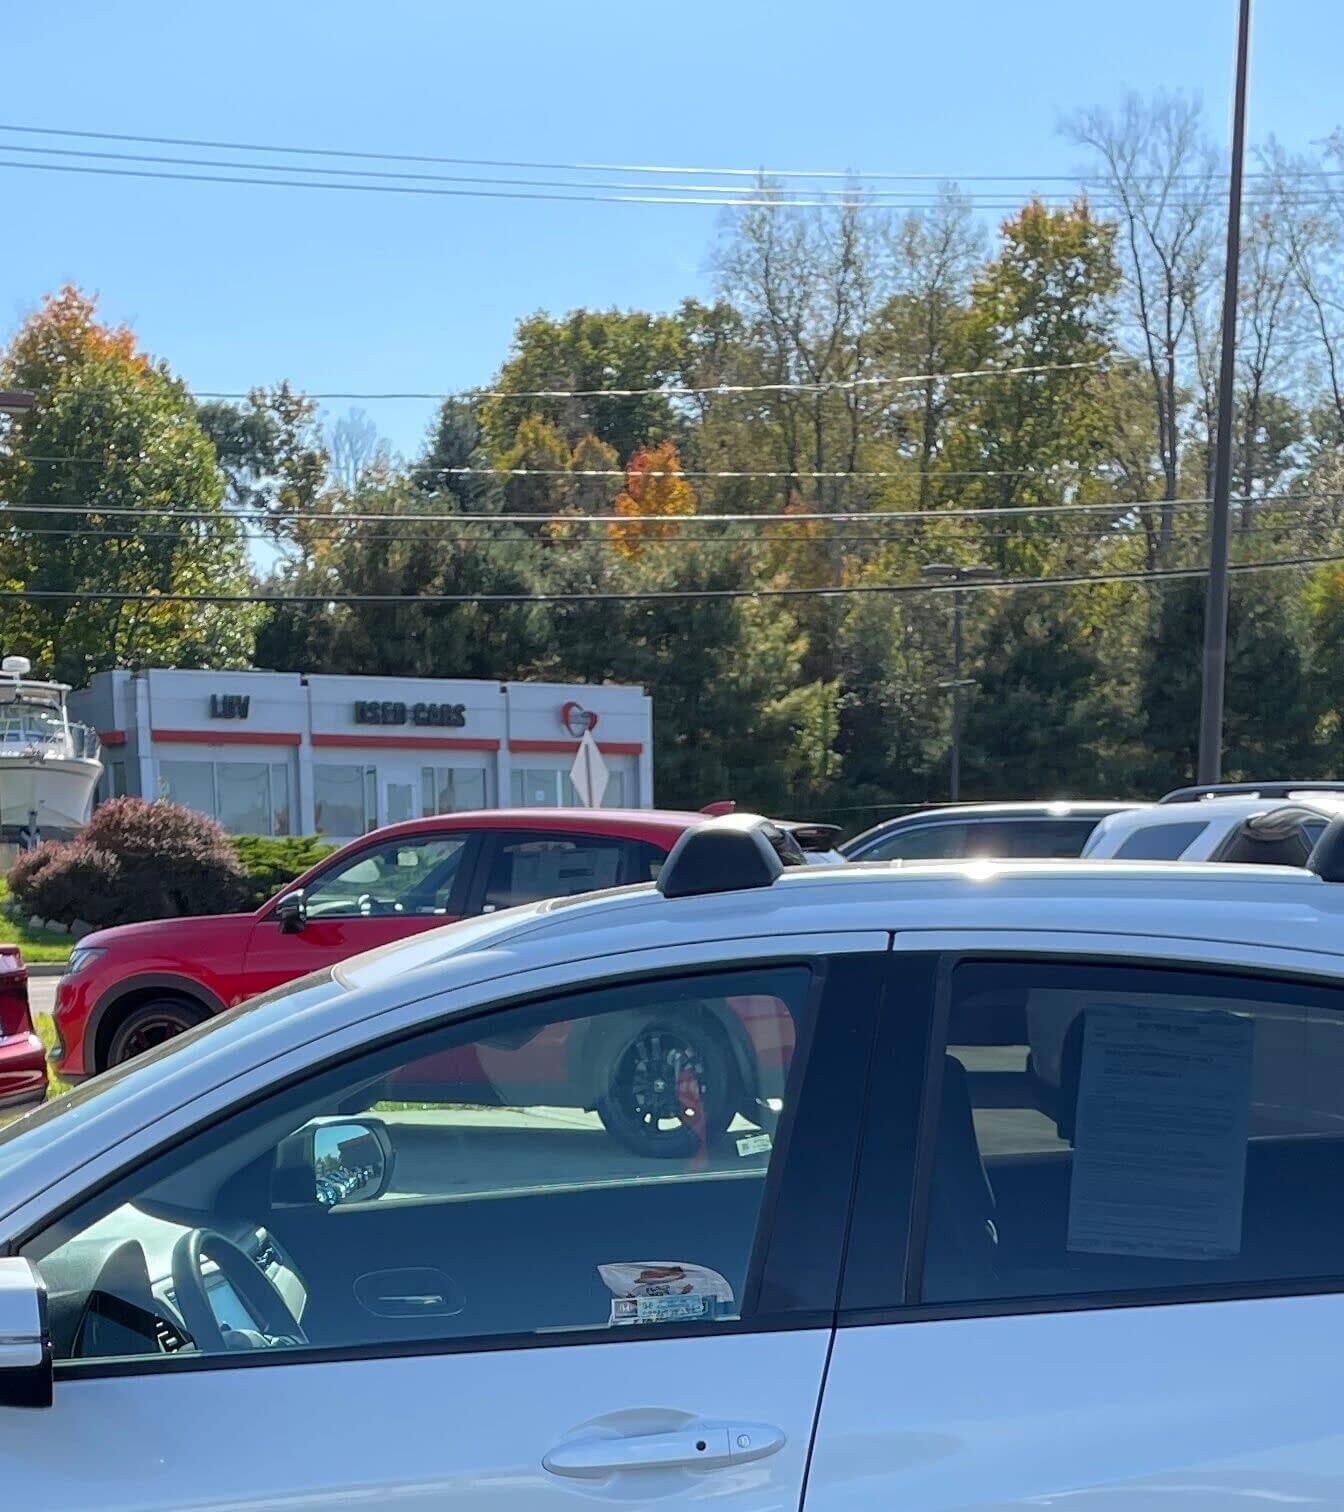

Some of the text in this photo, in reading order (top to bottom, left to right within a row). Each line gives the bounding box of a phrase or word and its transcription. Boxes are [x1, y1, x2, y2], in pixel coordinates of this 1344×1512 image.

[210, 694, 250, 719] LUV
[354, 701, 466, 727] USED CARS
